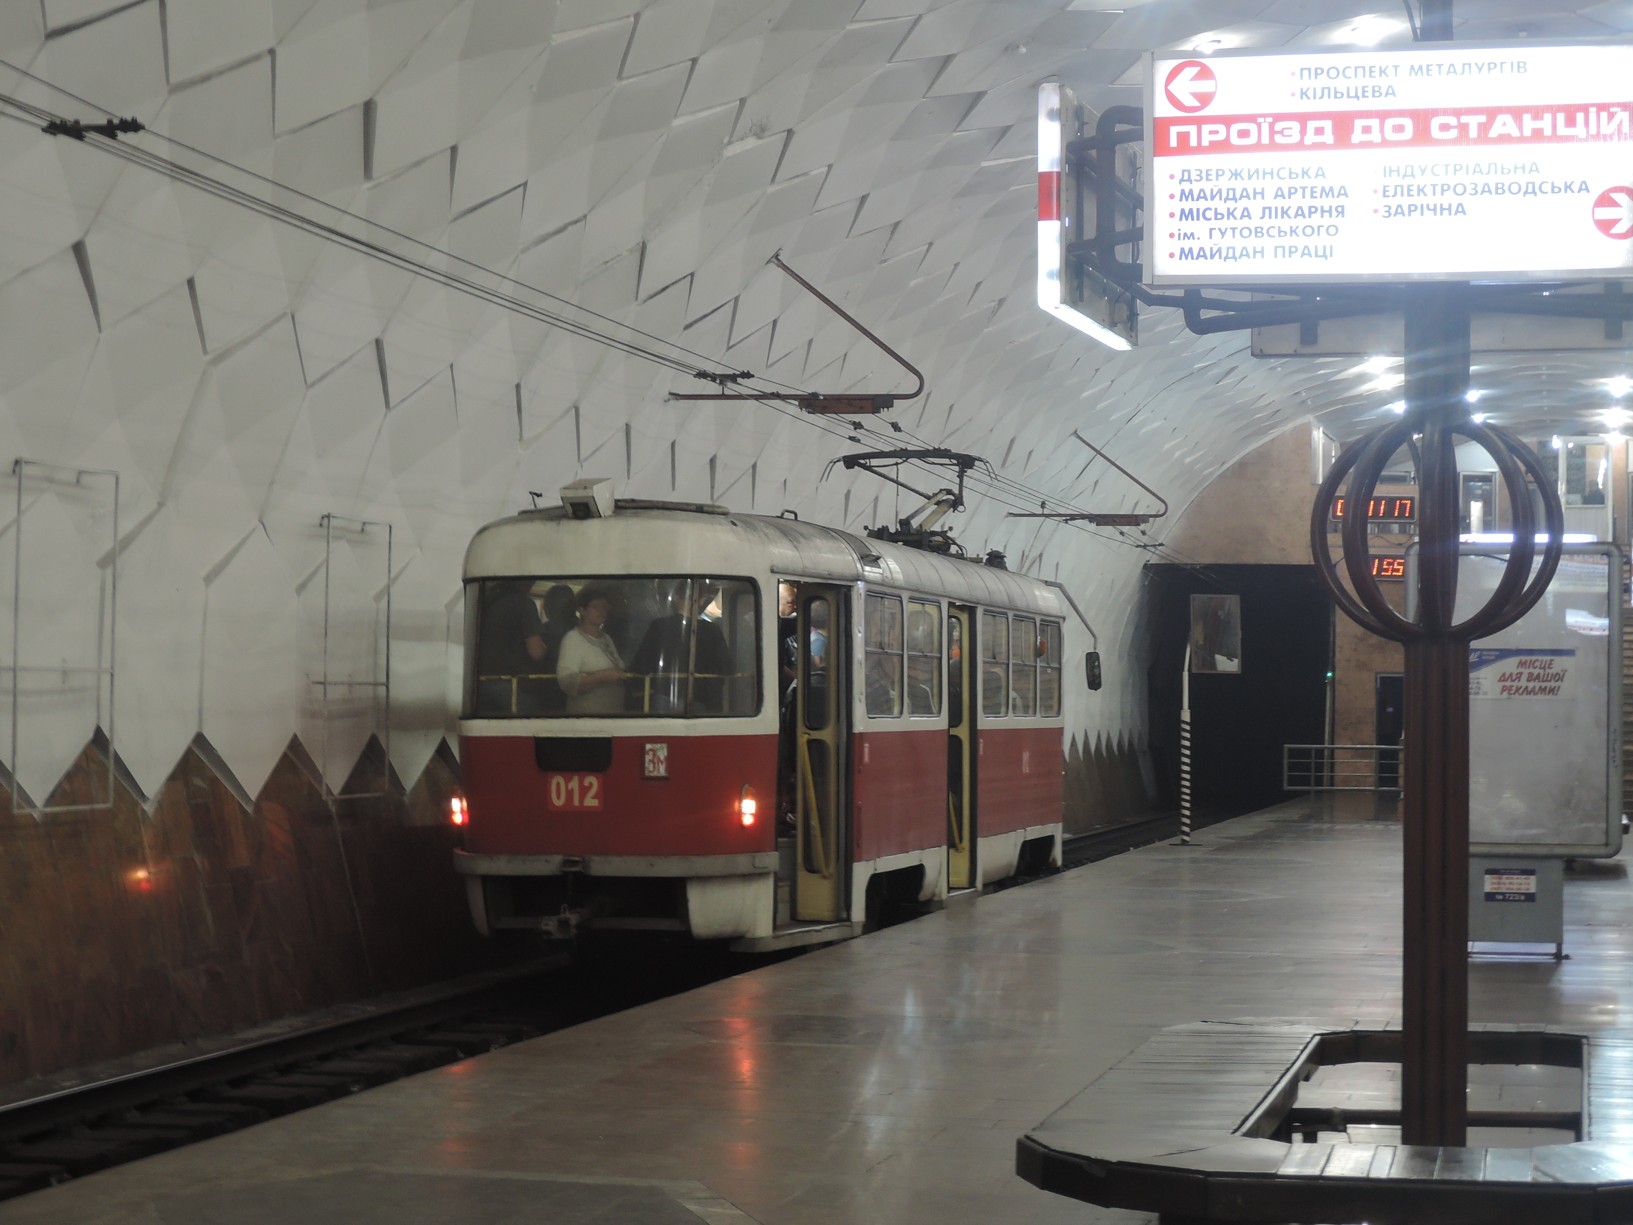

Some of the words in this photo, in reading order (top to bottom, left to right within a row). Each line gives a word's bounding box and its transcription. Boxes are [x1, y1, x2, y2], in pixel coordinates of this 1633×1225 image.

[1300, 64, 1400, 80] ПРОСПЕКТ
[1409, 60, 1528, 77] МЕТАЛУРГІВ
[1300, 84, 1397, 101] КІЛЬЦЕВА
[1169, 117, 1334, 147] ПРОЇЗД
[1351, 117, 1413, 144] ДО
[1430, 106, 1630, 142] СТАНЦІЙ
[1178, 166, 1327, 185] ДЗЕРЖИНСЬКА
[1383, 161, 1540, 179] ІНДУСТРІАЛЬНА
[1178, 185, 1265, 203] МАЙДАН
[1273, 185, 1349, 200] АРТЕМА
[1382, 180, 1591, 198] ЕЛЕКТРОЗАВОДСЬКА
[1178, 206, 1252, 222] МІСЬКА
[1259, 204, 1346, 220] ЛІКАРНЯ
[1382, 202, 1467, 218] ЗАРІЧНА
[1177, 228, 1201, 241] ім.
[1208, 224, 1339, 240] ГУТОВСЬКОГО
[1178, 244, 1265, 262] МАЙДАН
[1273, 244, 1334, 260] ПРАЦІ
[1516, 659, 1555, 672] МІСЦЕ
[1497, 671, 1524, 683] ДЛЯ
[1526, 669, 1568, 683] ВАШОЇ
[1499, 684, 1561, 696] РЕКЛАМИ!
[551, 775, 600, 807] 012
